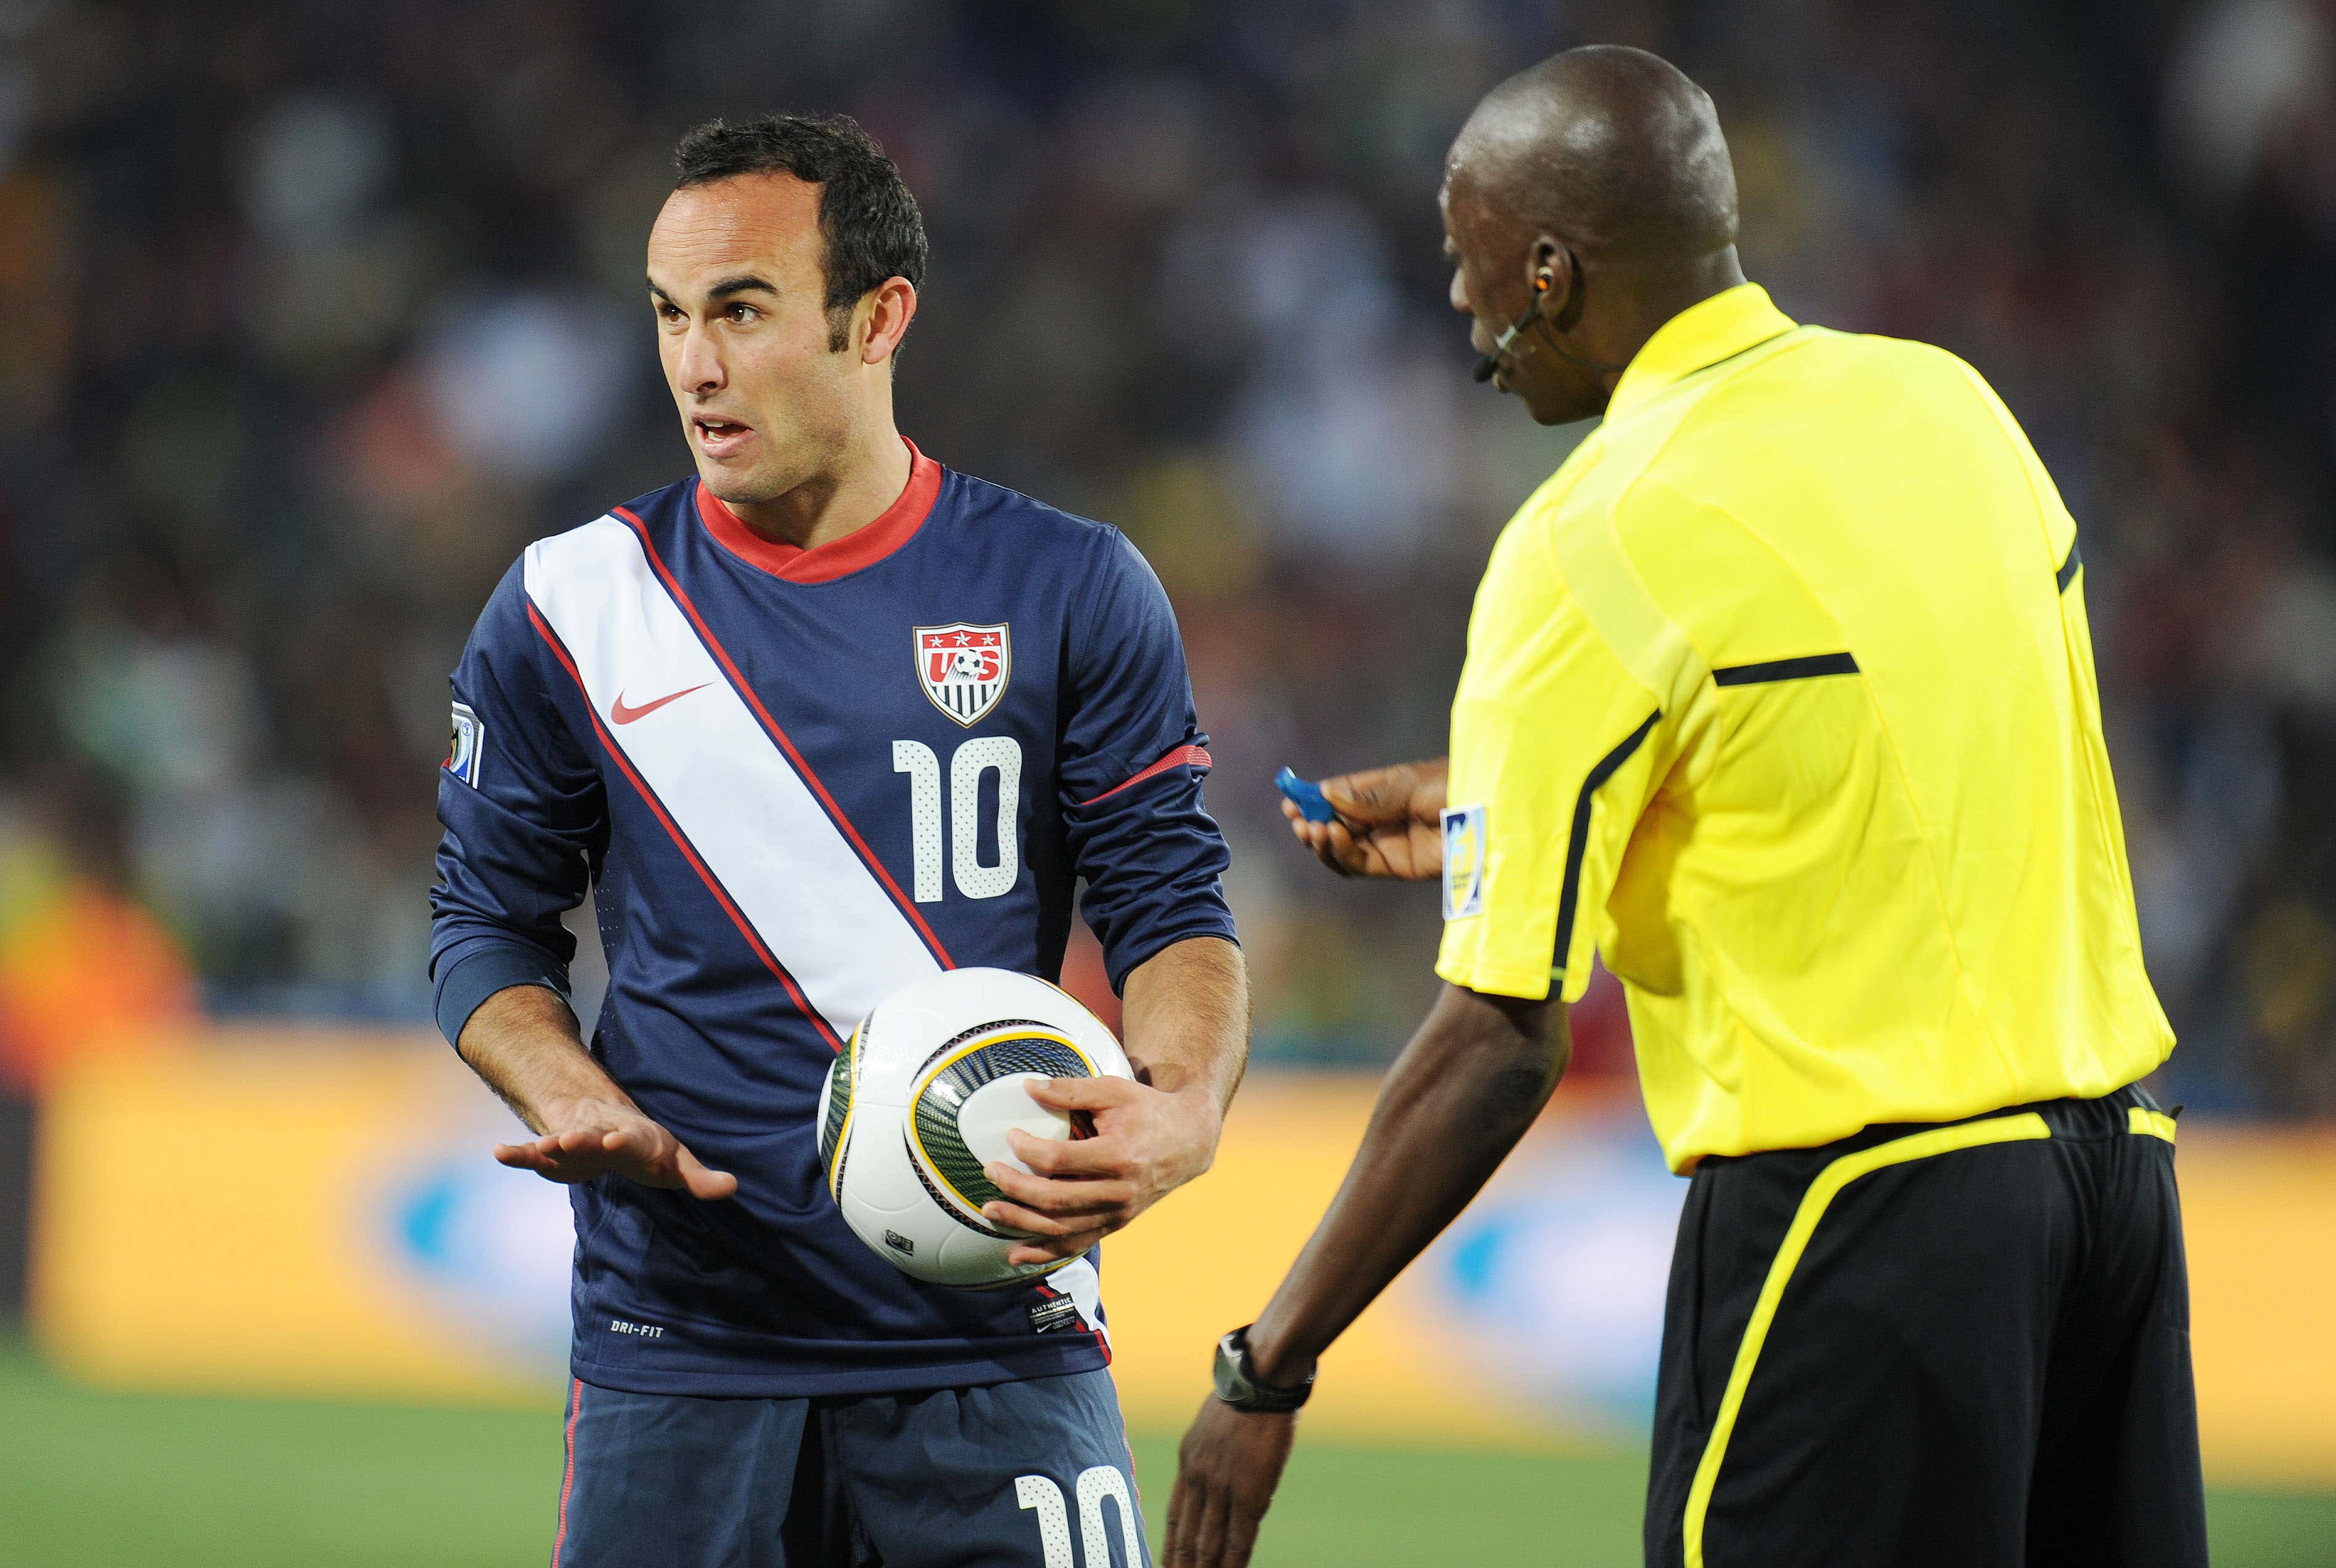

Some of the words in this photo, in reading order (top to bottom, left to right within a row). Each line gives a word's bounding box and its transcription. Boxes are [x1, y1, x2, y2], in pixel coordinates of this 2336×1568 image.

[930, 650, 1000, 682] US
[892, 737, 1022, 903] 10
[1031, 1297, 1072, 1314] AUTHENTIC
[610, 1320, 664, 1338] DRI-FIT
[1014, 1465, 1143, 1568] 10
